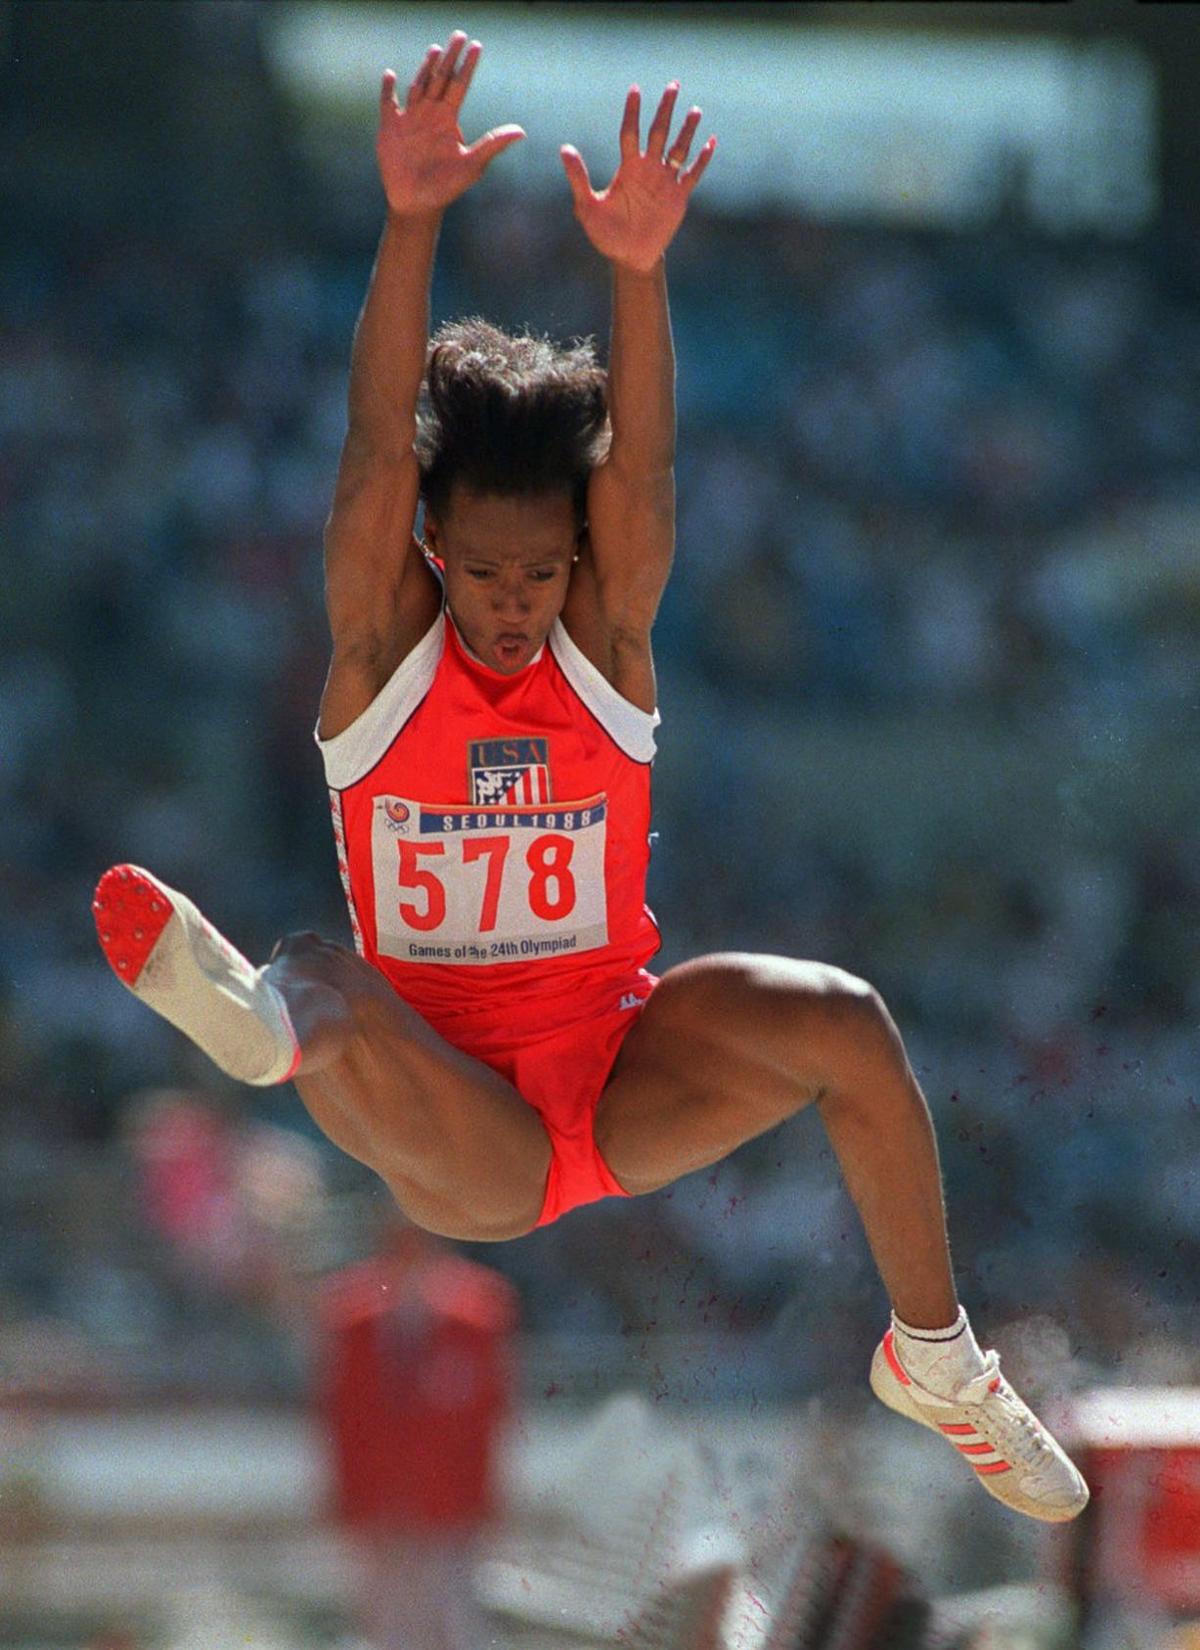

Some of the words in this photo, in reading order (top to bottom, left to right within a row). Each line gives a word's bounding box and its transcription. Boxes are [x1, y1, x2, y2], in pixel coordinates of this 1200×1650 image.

[478, 743, 541, 765] USA
[443, 815, 521, 831] SEOUL
[531, 811, 592, 830] 1988
[398, 834, 576, 932] 578
[409, 944, 451, 959] Games
[454, 945, 466, 958] of
[490, 941, 518, 958] 24th
[521, 935, 576, 954] Olympiad
